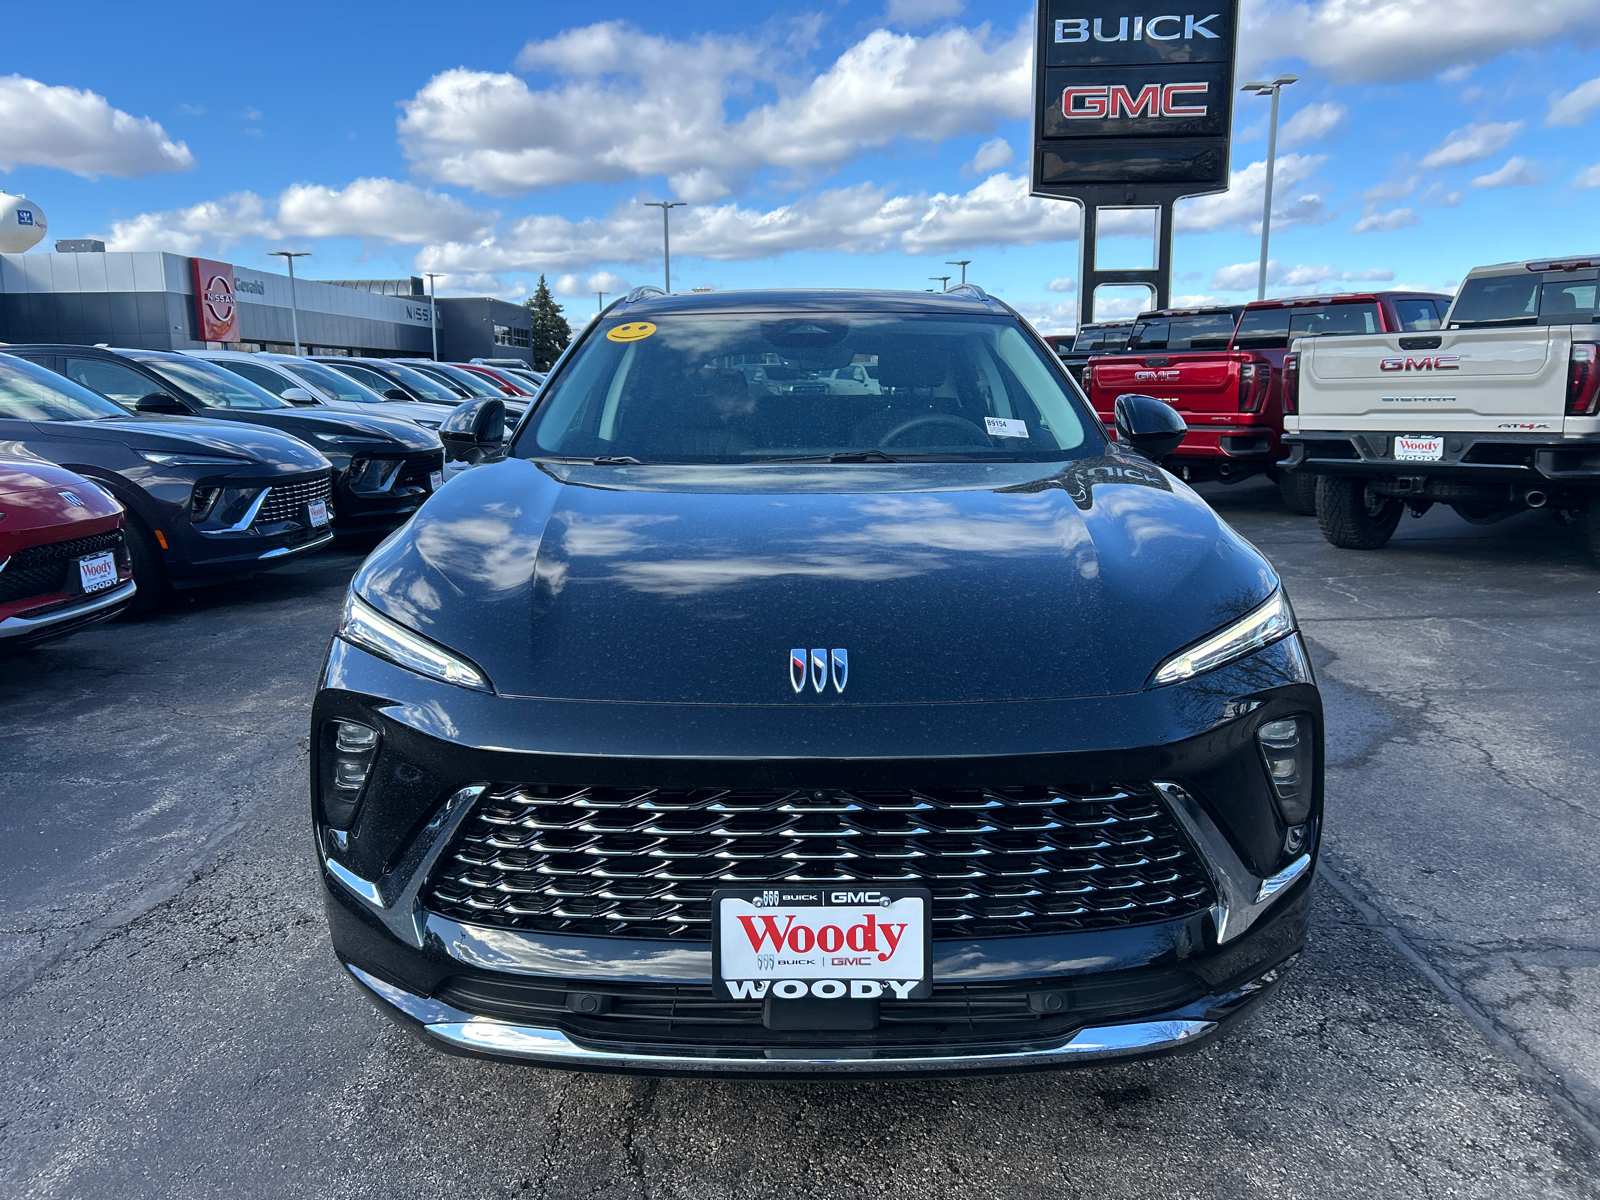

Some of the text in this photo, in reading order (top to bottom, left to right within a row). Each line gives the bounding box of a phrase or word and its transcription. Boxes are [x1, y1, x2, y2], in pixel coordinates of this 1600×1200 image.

[1054, 14, 1221, 43] BUICK
[1062, 82, 1209, 119] GMC
[234, 277, 265, 295] Gerald
[206, 293, 235, 304] NISSAN
[1380, 355, 1460, 372] GMC
[1134, 370, 1180, 382] GMC
[1497, 422, 1550, 430] AT4X
[1399, 440, 1440, 453] Woody
[82, 560, 112, 578] Woody
[84, 577, 118, 593] WOODY
[831, 891, 881, 903] GMC
[736, 914, 908, 962] Woody
[831, 957, 872, 966] GMC
[725, 979, 919, 999] WOODY
